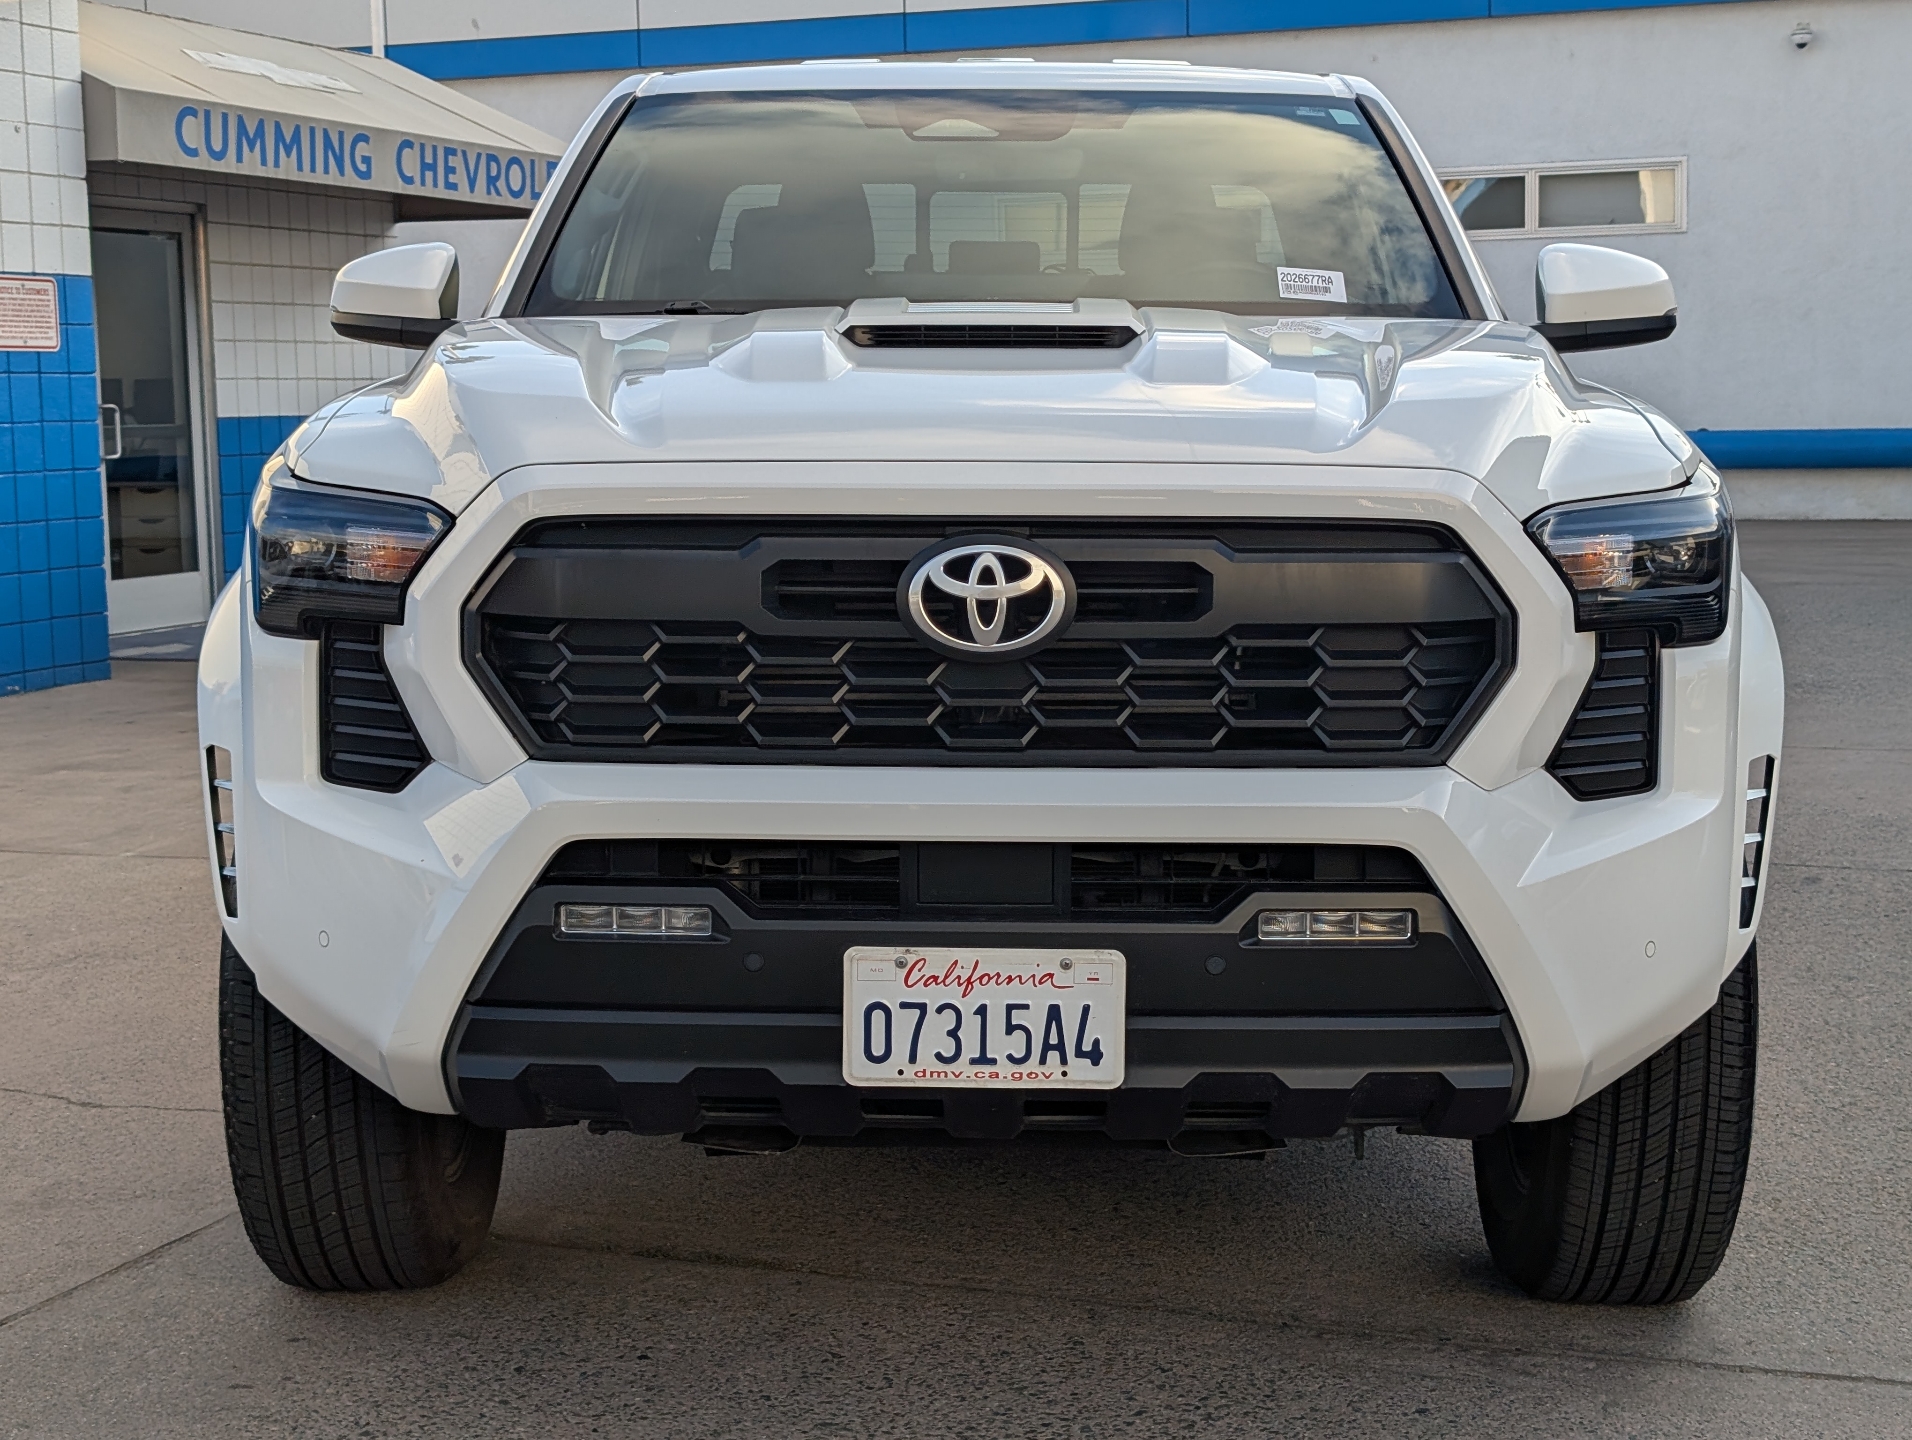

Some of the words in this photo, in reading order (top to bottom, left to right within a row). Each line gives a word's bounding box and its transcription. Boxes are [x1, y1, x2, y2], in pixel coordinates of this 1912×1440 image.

[175, 106, 373, 180] CUMMING
[1280, 272, 1334, 286] 2026677RA
[903, 957, 1075, 999] California
[863, 1000, 1104, 1067] 07315A4
[913, 1068, 1055, 1081] dmv.ca.gov
